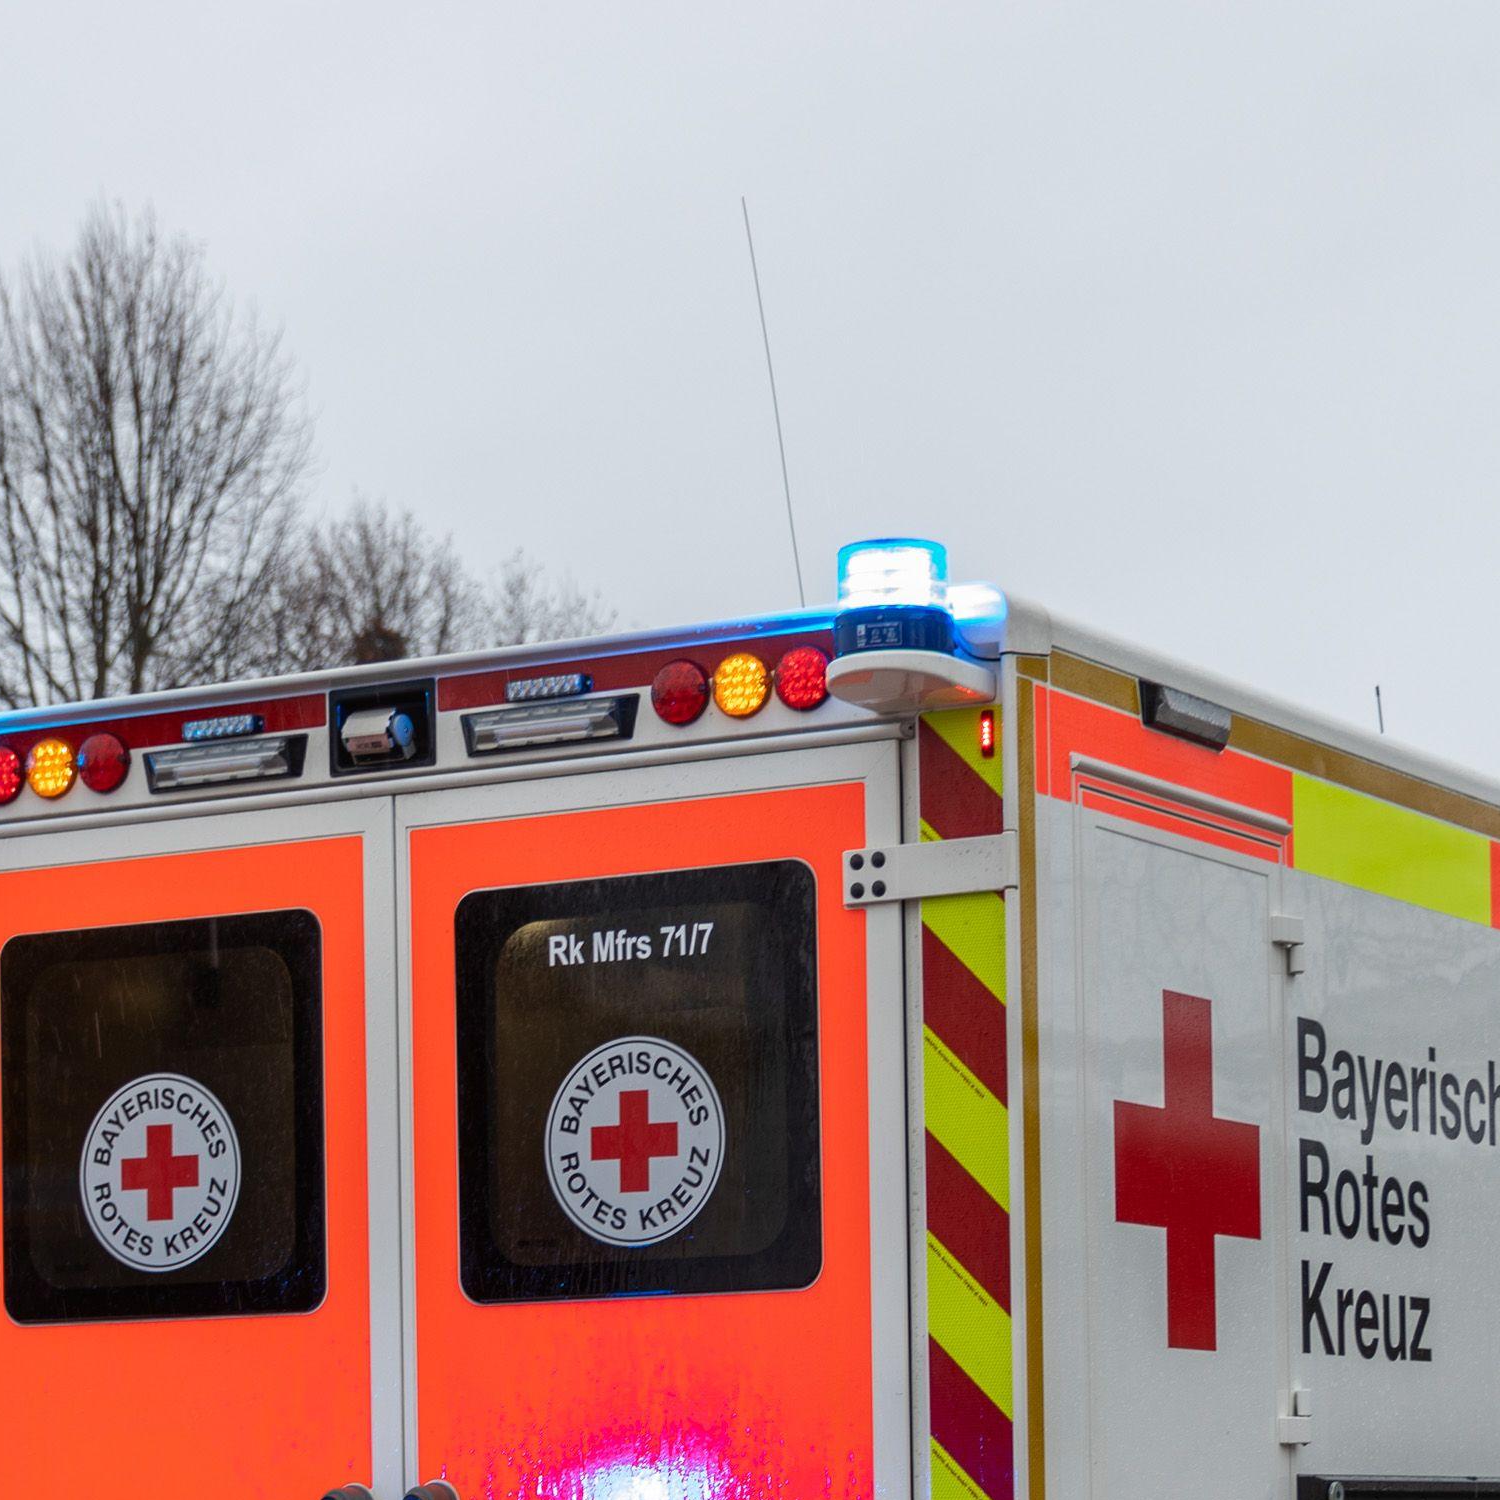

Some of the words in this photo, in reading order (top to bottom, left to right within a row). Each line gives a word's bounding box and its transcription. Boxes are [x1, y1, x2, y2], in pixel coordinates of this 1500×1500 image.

[548, 933, 585, 967] Rk
[592, 929, 652, 963] Mfrs
[660, 922, 714, 957] 71/7
[94, 1088, 226, 1166] BAYERISCHES
[560, 1051, 709, 1135] BAYERISCHES
[94, 1182, 153, 1256] ROTES
[164, 1177, 227, 1257] KREUZ
[560, 1152, 627, 1230] ROTES
[639, 1146, 710, 1231] KREUZ
[1299, 1137, 1430, 1249] Rotes
[1301, 1259, 1432, 1362] Kreuz
